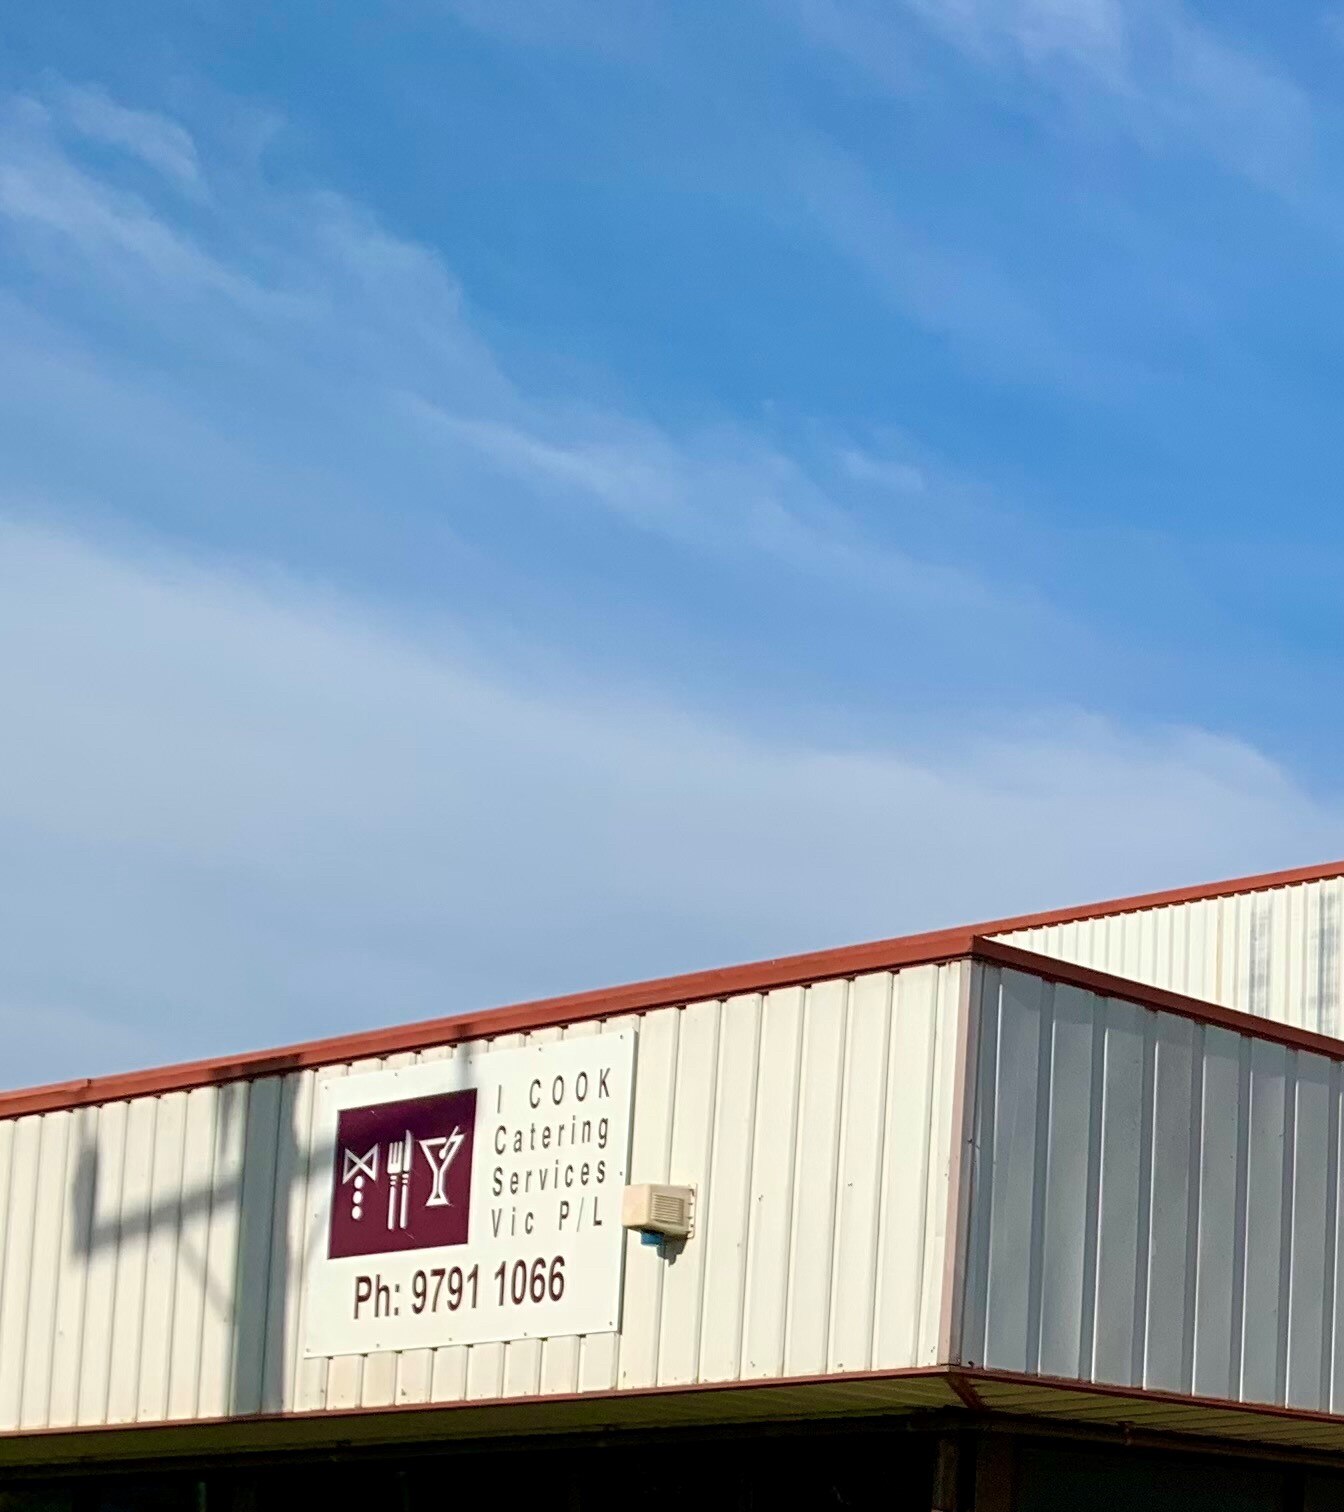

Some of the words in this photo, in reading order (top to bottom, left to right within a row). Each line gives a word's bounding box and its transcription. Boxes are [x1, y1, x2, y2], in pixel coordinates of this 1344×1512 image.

[529, 1067, 611, 1109] COOK
[494, 1115, 609, 1155] Catering
[492, 1159, 606, 1197] Services
[491, 1206, 534, 1238] Vic
[558, 1196, 603, 1233] P/L
[353, 1273, 400, 1320] Ph:
[411, 1263, 480, 1315] 9791
[494, 1255, 566, 1306] 1066
